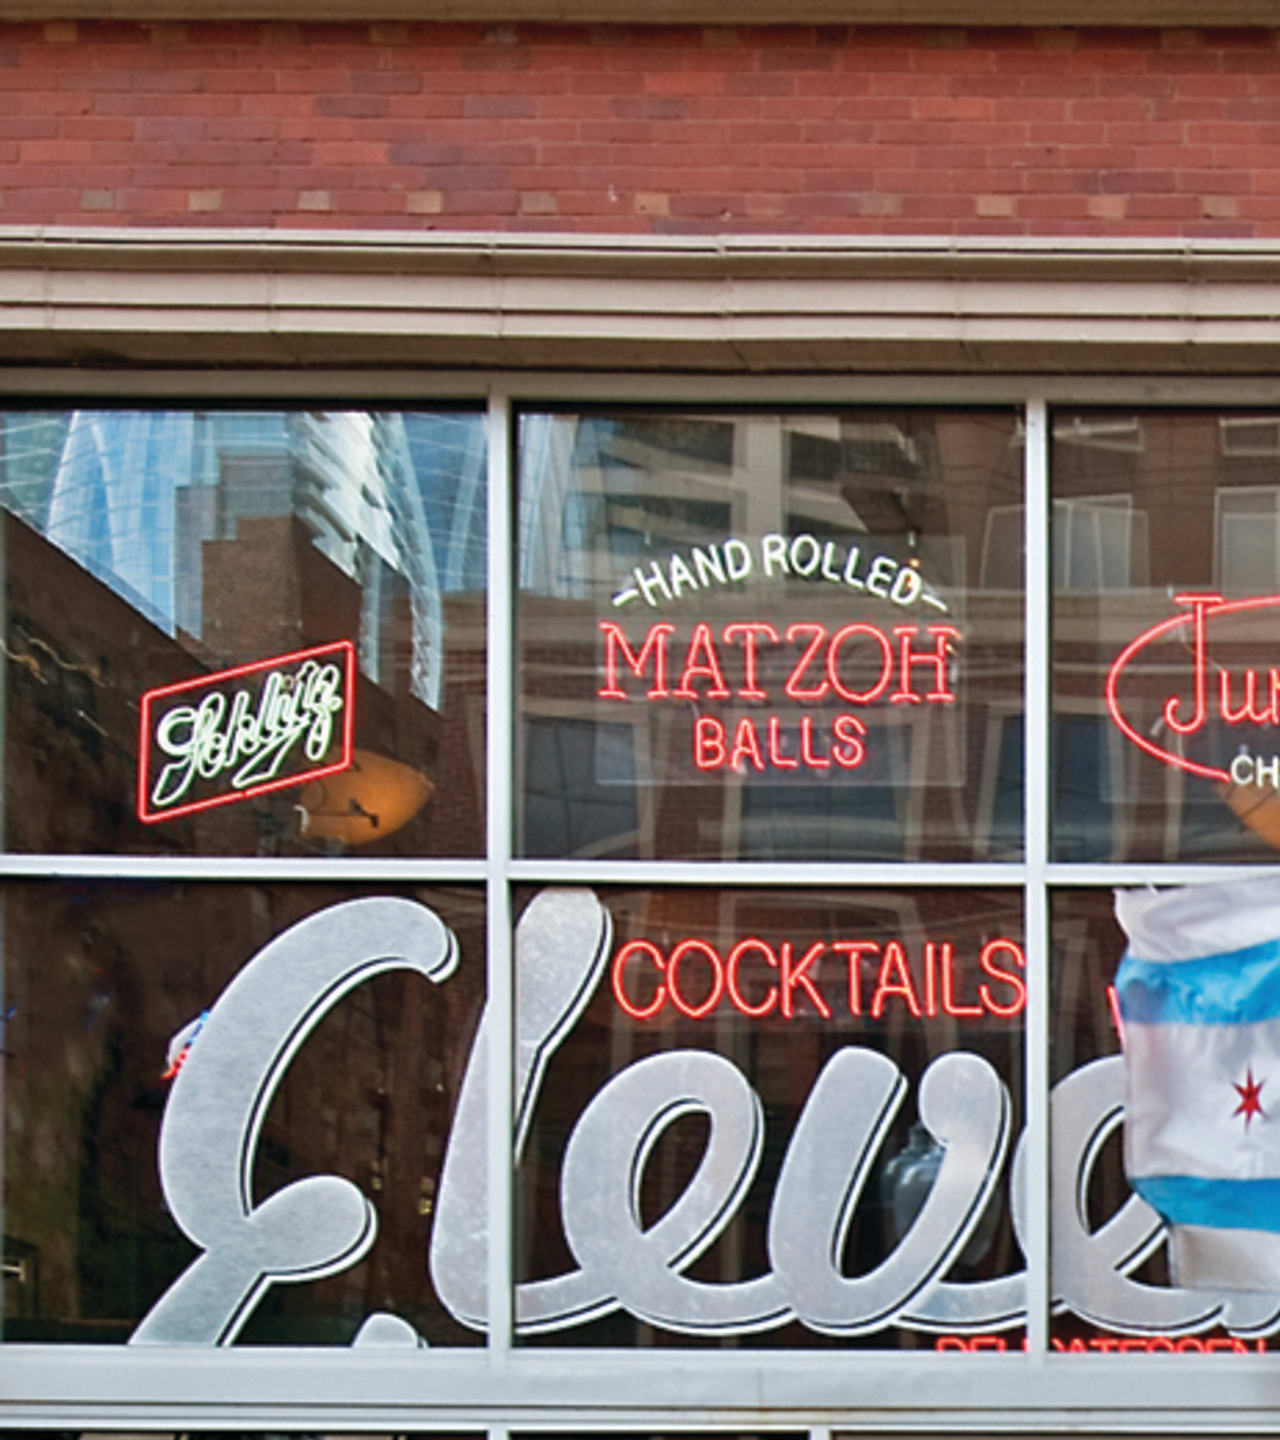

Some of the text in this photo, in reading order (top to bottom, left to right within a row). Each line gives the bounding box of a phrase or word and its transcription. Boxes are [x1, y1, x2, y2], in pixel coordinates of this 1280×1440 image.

[631, 533, 924, 606] HAND ROLLED
[598, 621, 964, 704] MATZOH
[691, 714, 867, 771] BALLS
[611, 939, 1027, 1019] COCKTAILS
